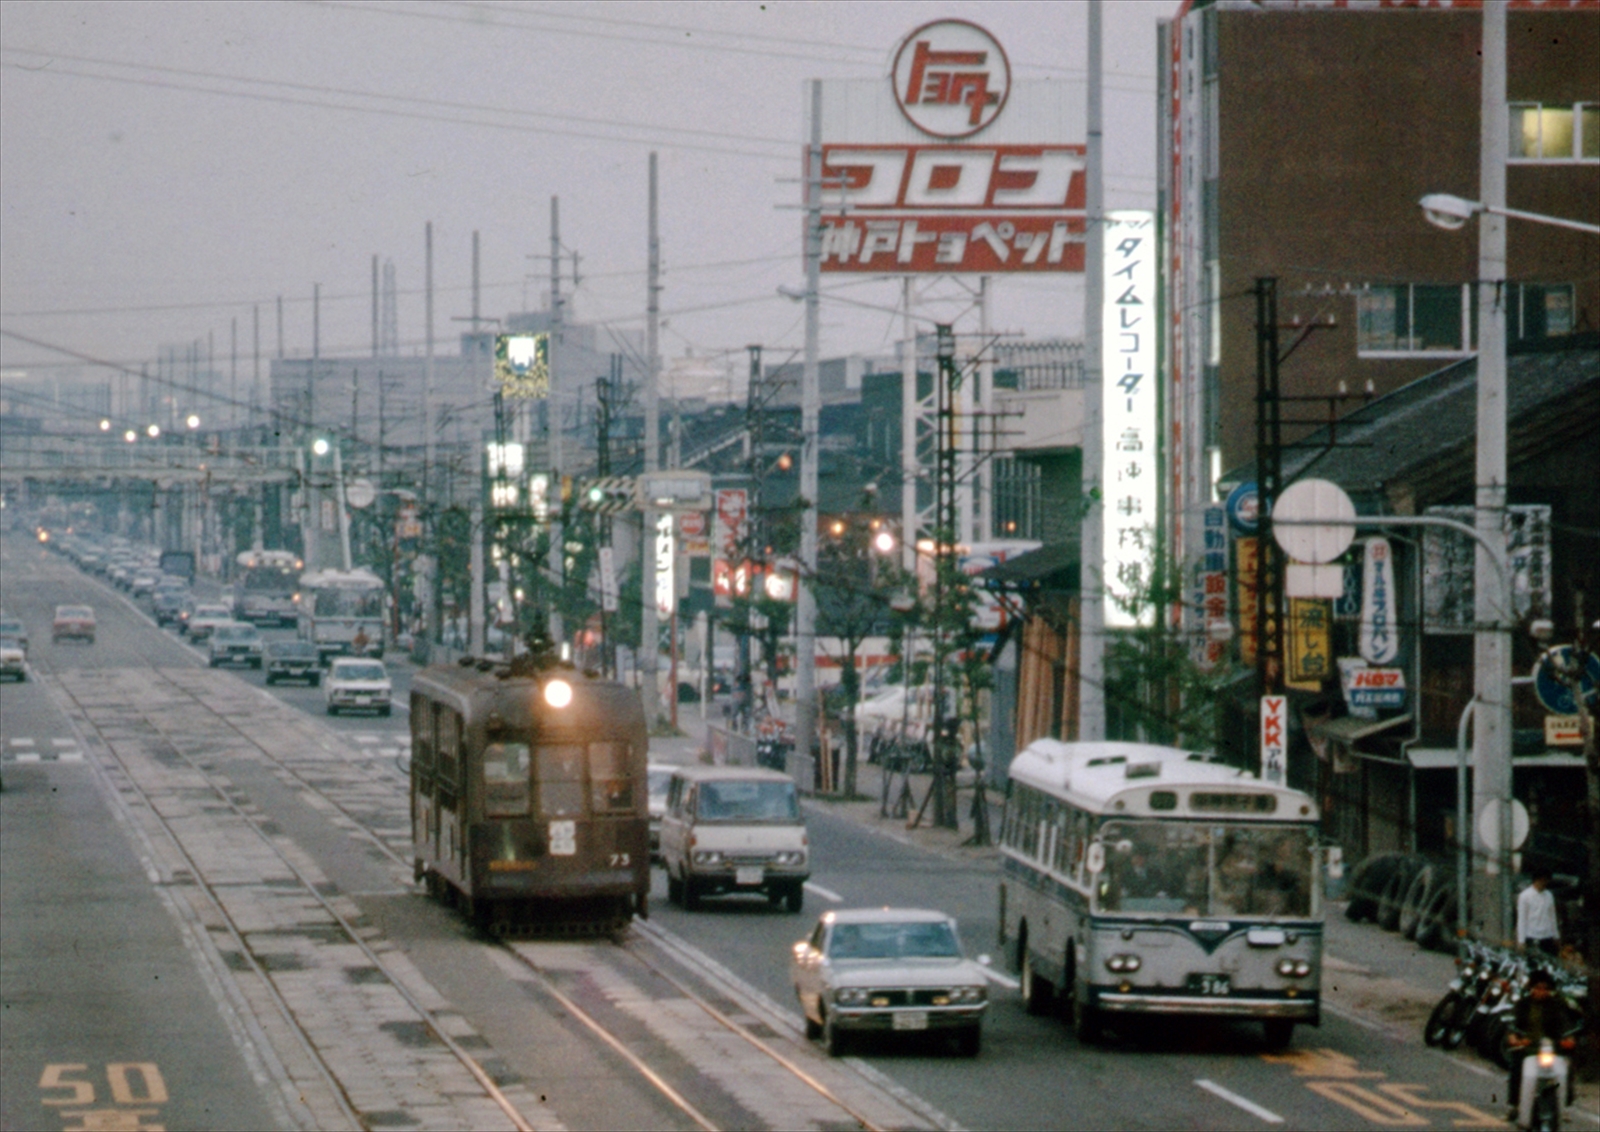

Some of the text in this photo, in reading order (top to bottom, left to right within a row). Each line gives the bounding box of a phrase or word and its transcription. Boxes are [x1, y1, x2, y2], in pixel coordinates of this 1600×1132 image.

[821, 150, 1086, 206] コロナ
[1112, 237, 1144, 413] タイムレコーダー
[1355, 671, 1399, 687] パロマ
[1265, 699, 1282, 747] YKK
[610, 853, 630, 867] 73
[37, 1062, 169, 1105] 50
